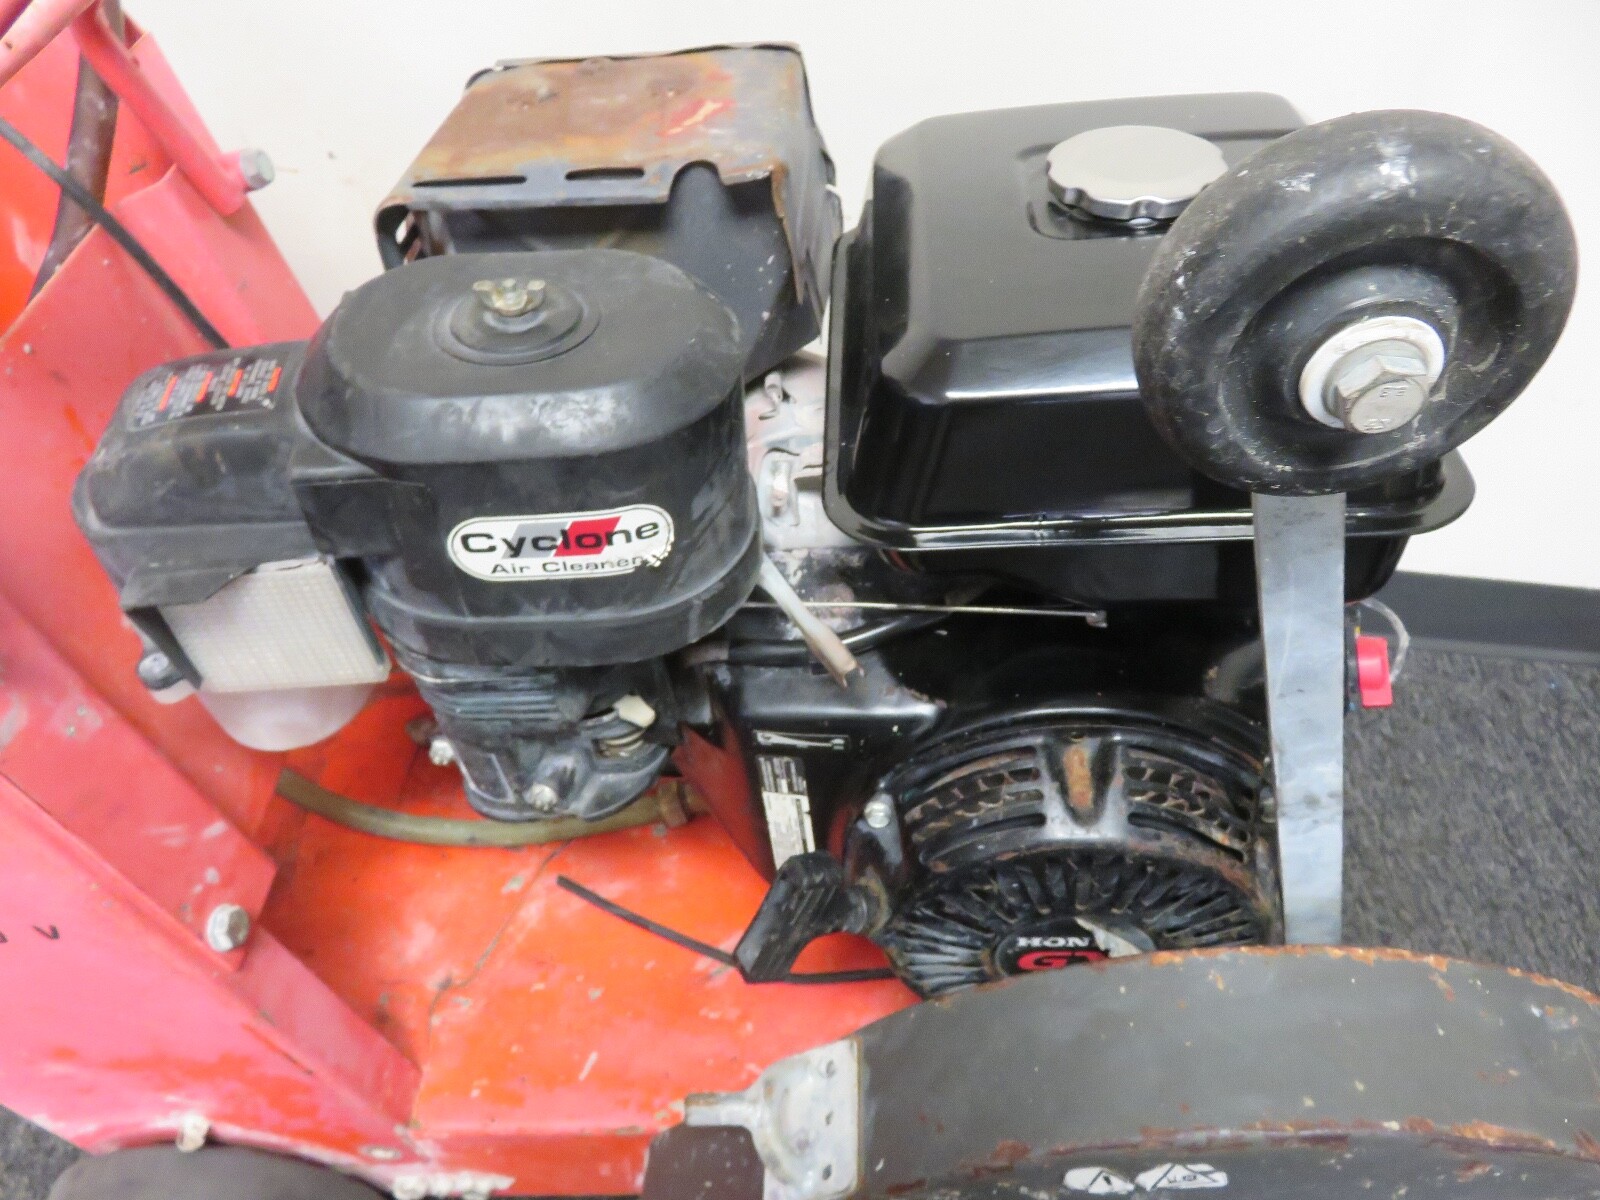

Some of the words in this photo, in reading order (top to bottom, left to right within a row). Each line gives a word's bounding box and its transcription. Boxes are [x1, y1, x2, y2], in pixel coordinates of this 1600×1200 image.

[461, 521, 659, 558] Cyclone
[490, 562, 530, 575] Air
[542, 556, 643, 573] Cleaner
[1016, 936, 1090, 948] HON
